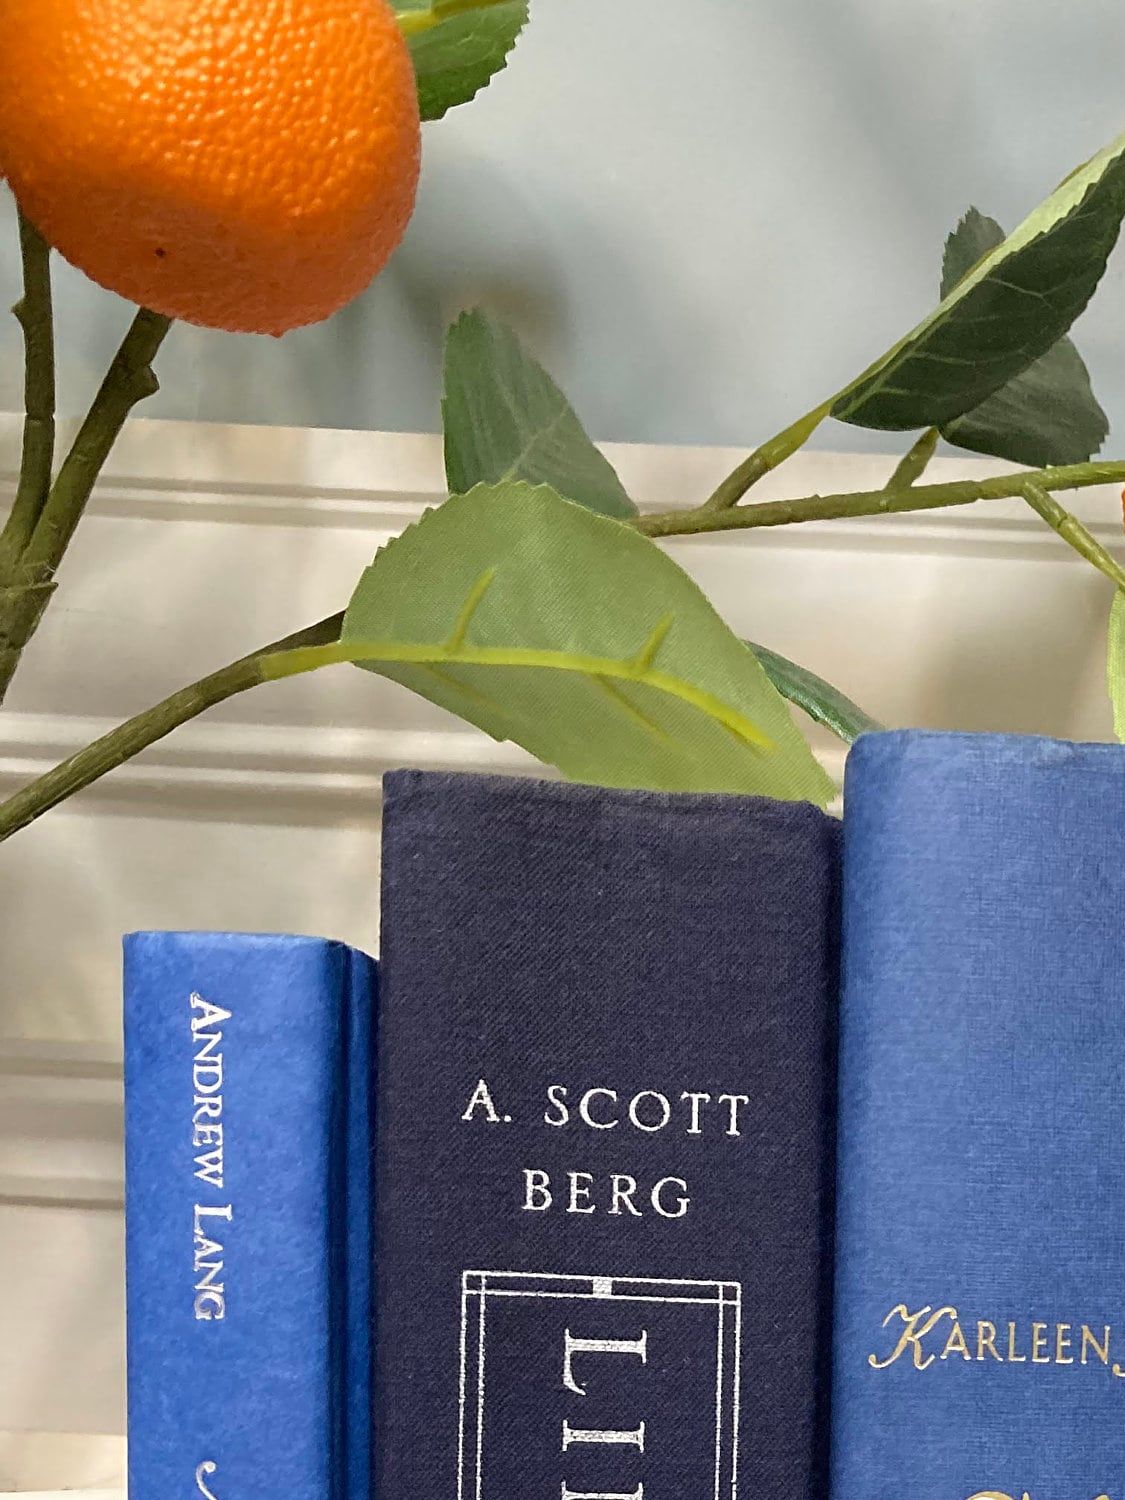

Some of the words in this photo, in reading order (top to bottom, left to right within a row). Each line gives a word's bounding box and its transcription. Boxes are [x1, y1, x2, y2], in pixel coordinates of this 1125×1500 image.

[189, 990, 233, 1188] ANDREW
[461, 1079, 513, 1123] A.
[544, 1084, 750, 1137] SCOTT
[521, 1168, 691, 1219] BERG
[193, 1203, 233, 1321] LANG
[868, 1303, 1112, 1371] KARLEEN
